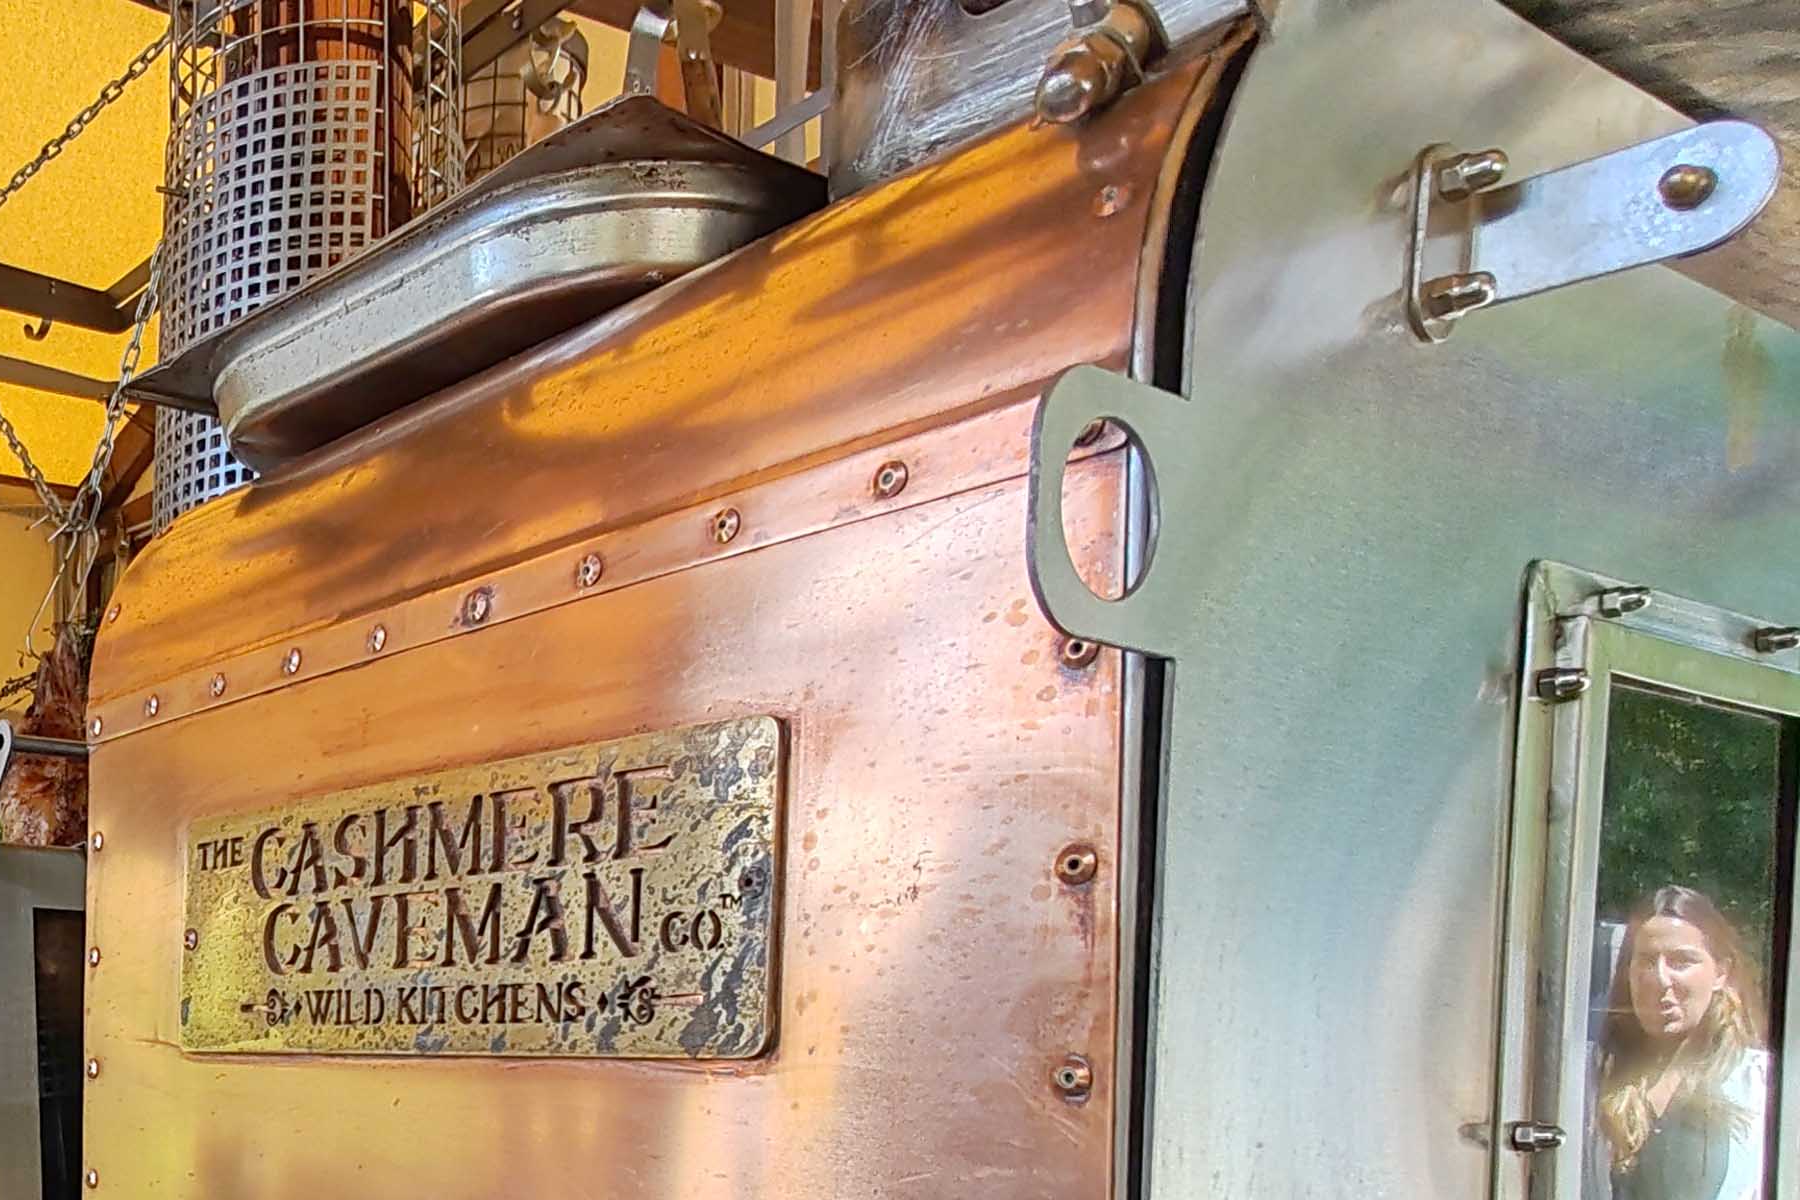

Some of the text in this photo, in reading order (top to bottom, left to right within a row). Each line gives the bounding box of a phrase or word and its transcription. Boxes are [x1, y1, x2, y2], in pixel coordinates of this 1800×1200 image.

[197, 765, 678, 900] THE CASHMERE
[262, 868, 646, 976] CAVEMAN
[303, 980, 587, 1026] WILD KITCHENS
